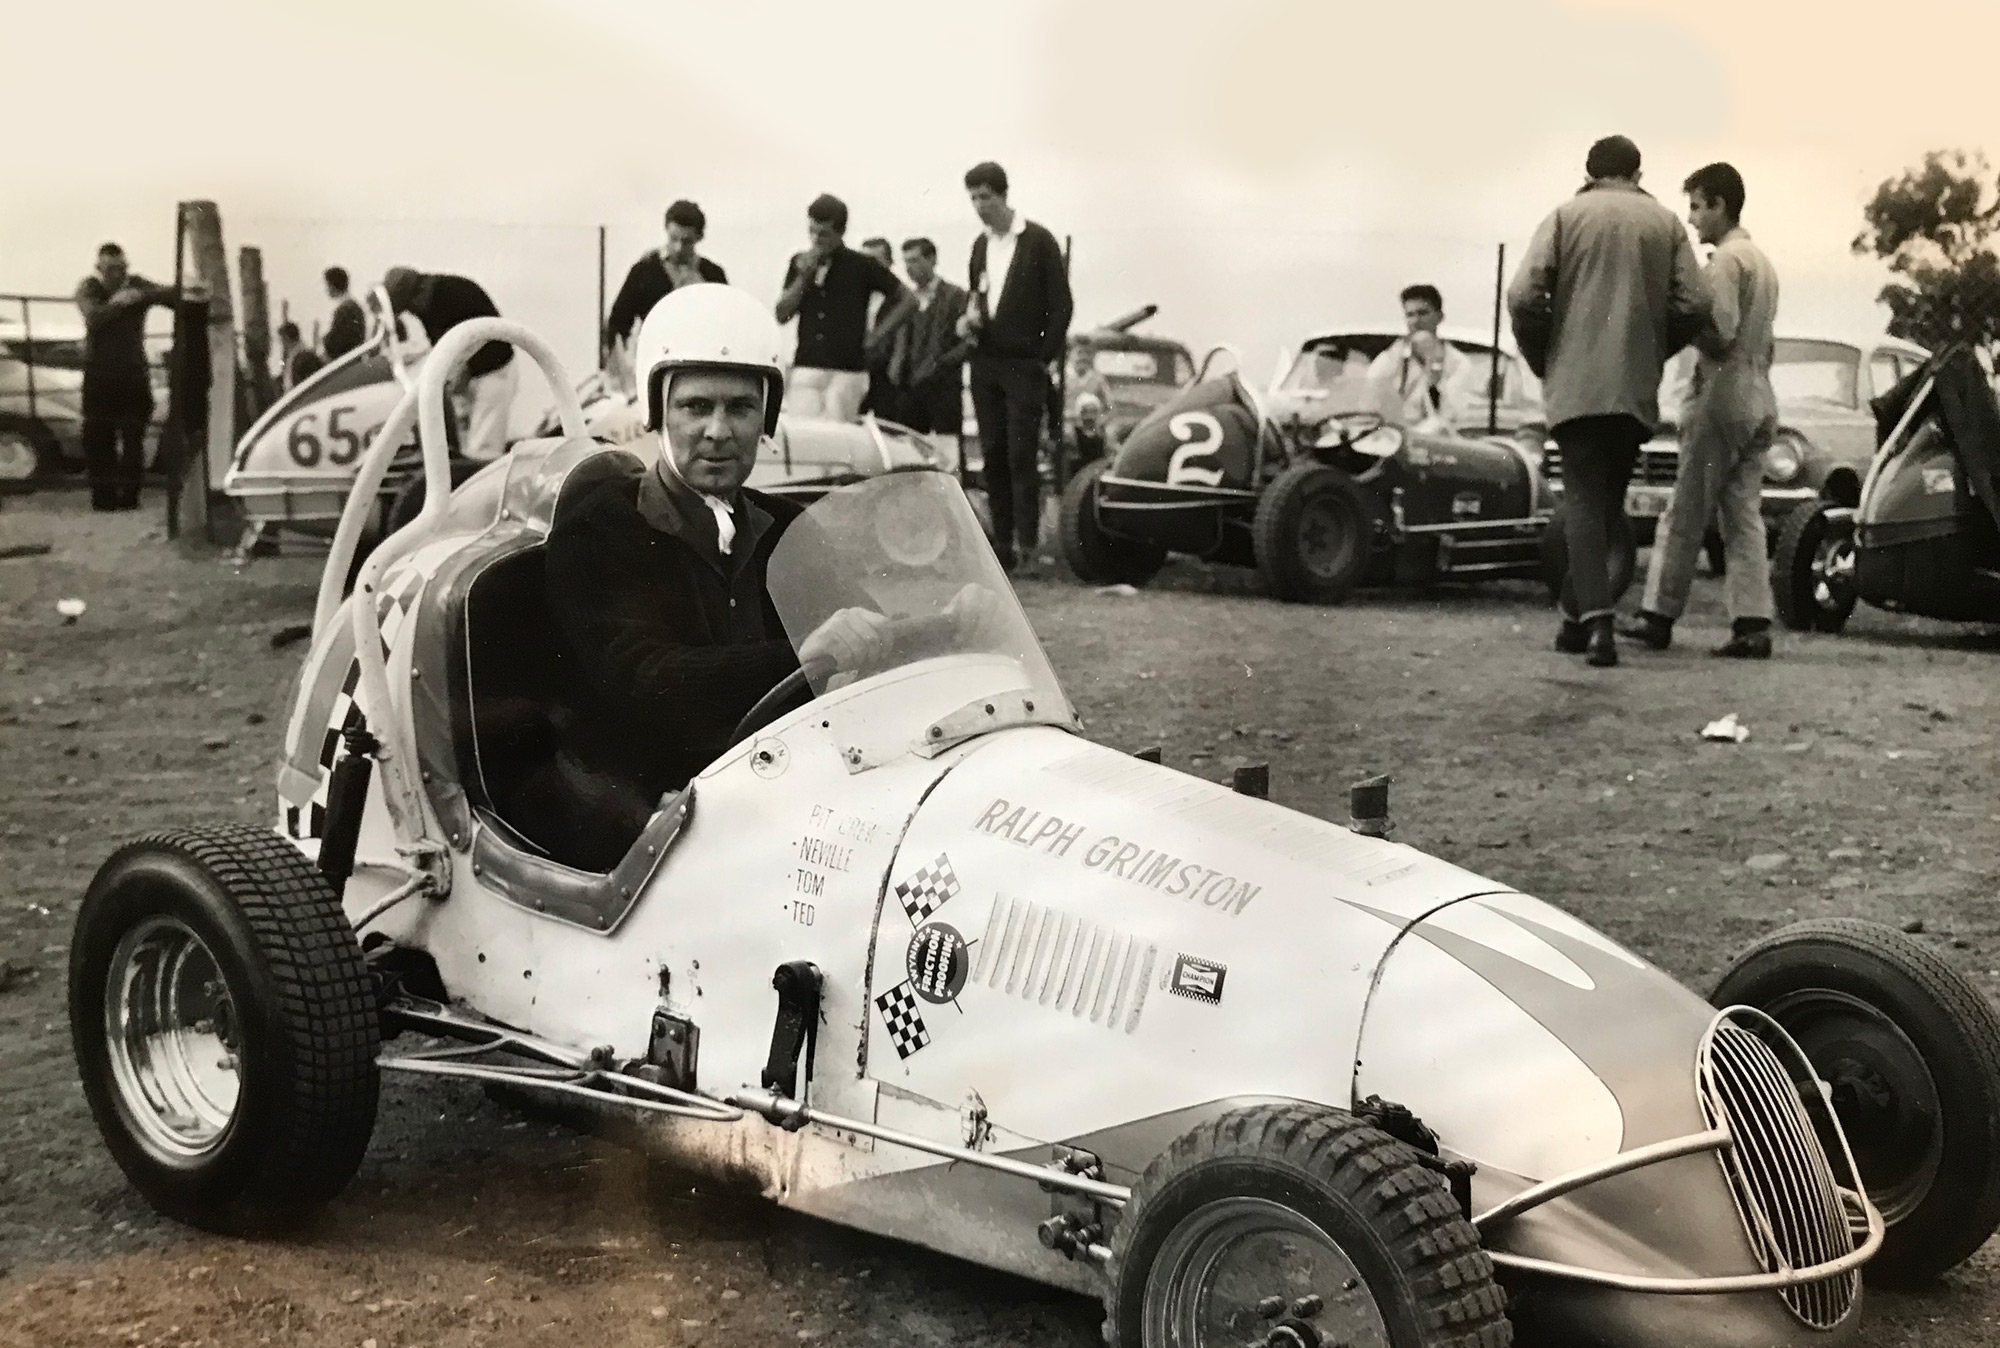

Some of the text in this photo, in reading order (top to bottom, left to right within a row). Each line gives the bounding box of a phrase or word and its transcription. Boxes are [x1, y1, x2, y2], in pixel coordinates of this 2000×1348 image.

[1166, 411, 1225, 487] 2
[808, 804, 835, 829] PIT
[800, 836, 854, 872] NEVILLE
[972, 798, 1263, 917] RALPH GRIMSTON
[796, 868, 825, 897] TOM
[792, 900, 815, 927] TED
[908, 931, 926, 982] WYNN'S
[921, 928, 942, 993] FRICTION
[934, 933, 955, 998] PROOFING
[1182, 970, 1215, 986] CHAMPION
